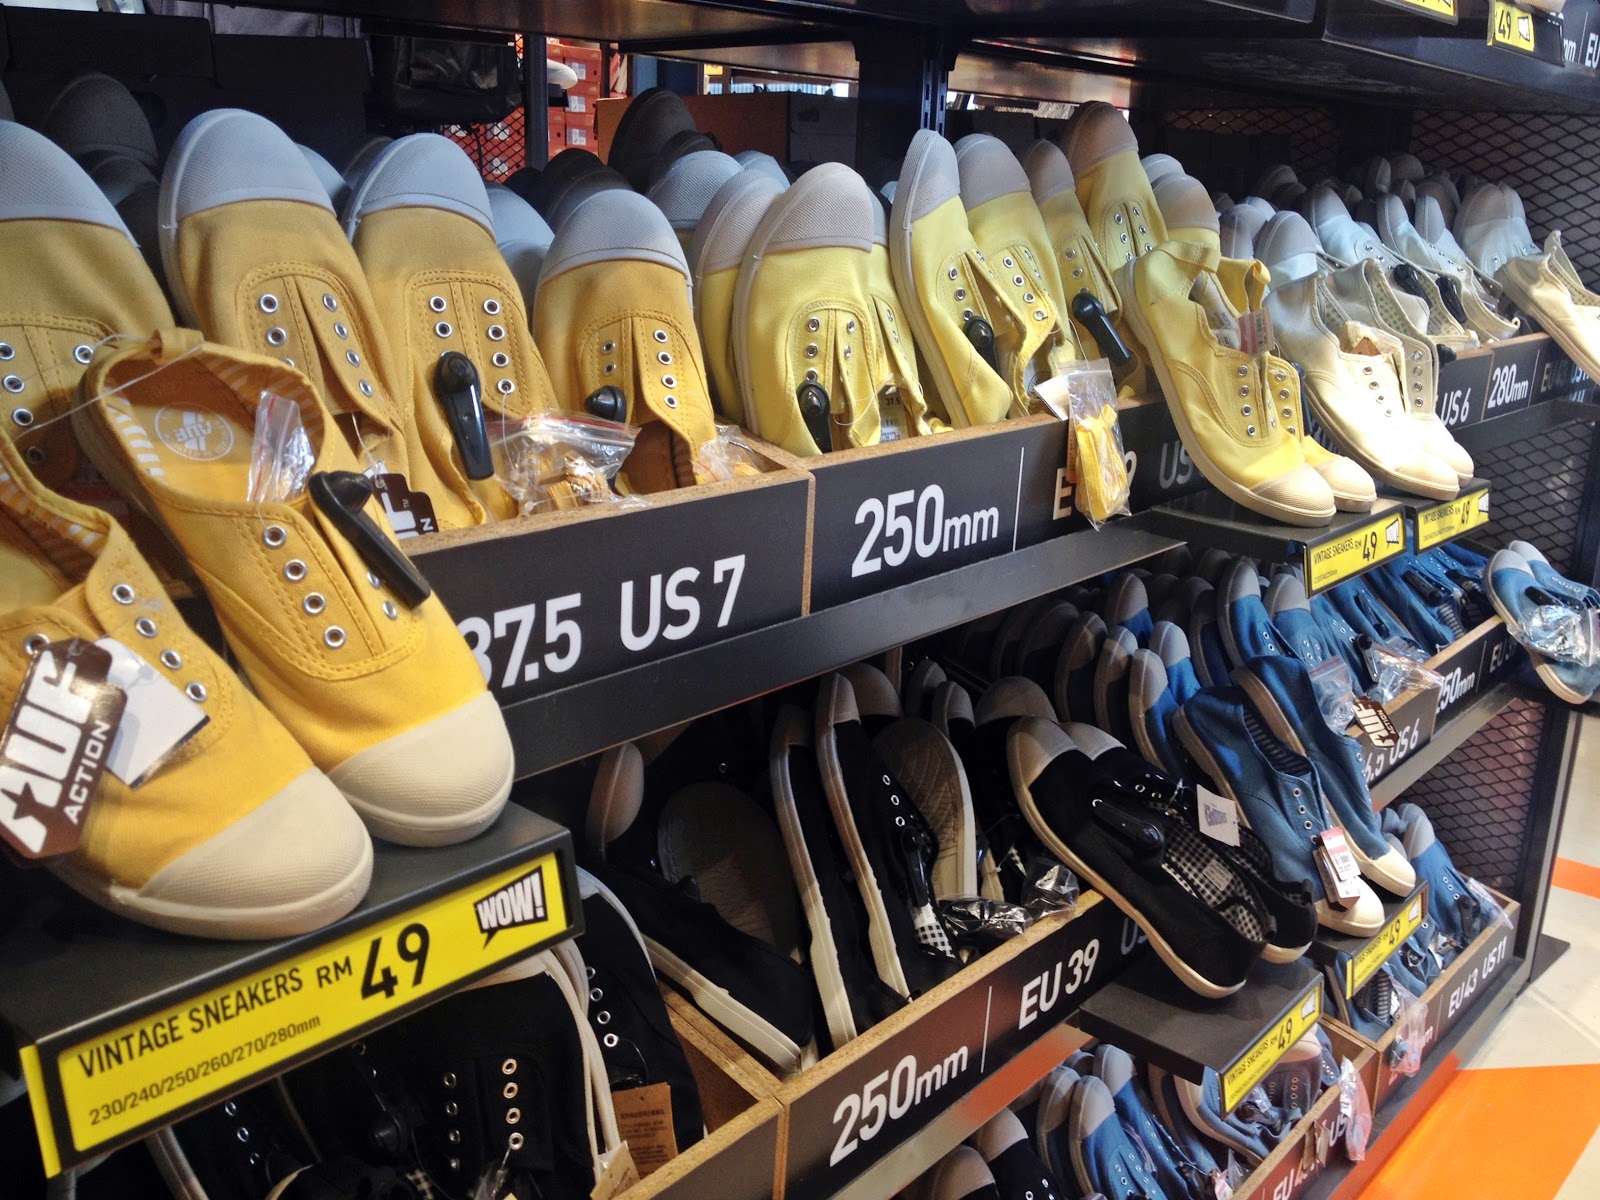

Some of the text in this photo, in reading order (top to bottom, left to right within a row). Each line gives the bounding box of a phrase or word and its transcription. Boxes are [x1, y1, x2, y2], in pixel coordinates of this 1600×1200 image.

[1498, 10, 1512, 40] 49
[1487, 364, 1529, 409] 280mm
[851, 484, 999, 578] 250mm
[1362, 531, 1377, 561] 49
[620, 566, 700, 652] US
[713, 554, 746, 628] 7
[1436, 667, 1475, 714] 50mm
[63, 720, 111, 825] ACTION
[78, 872, 546, 1079] VINTAGE SNEAKERS RM 49 WOW!
[89, 1014, 322, 1125] 230/240/250/260/270/280mm
[829, 1045, 969, 1168] 250mm
[1018, 961, 1062, 1030] EU
[1066, 938, 1100, 995] 39
[1278, 1018, 1293, 1049] 49
